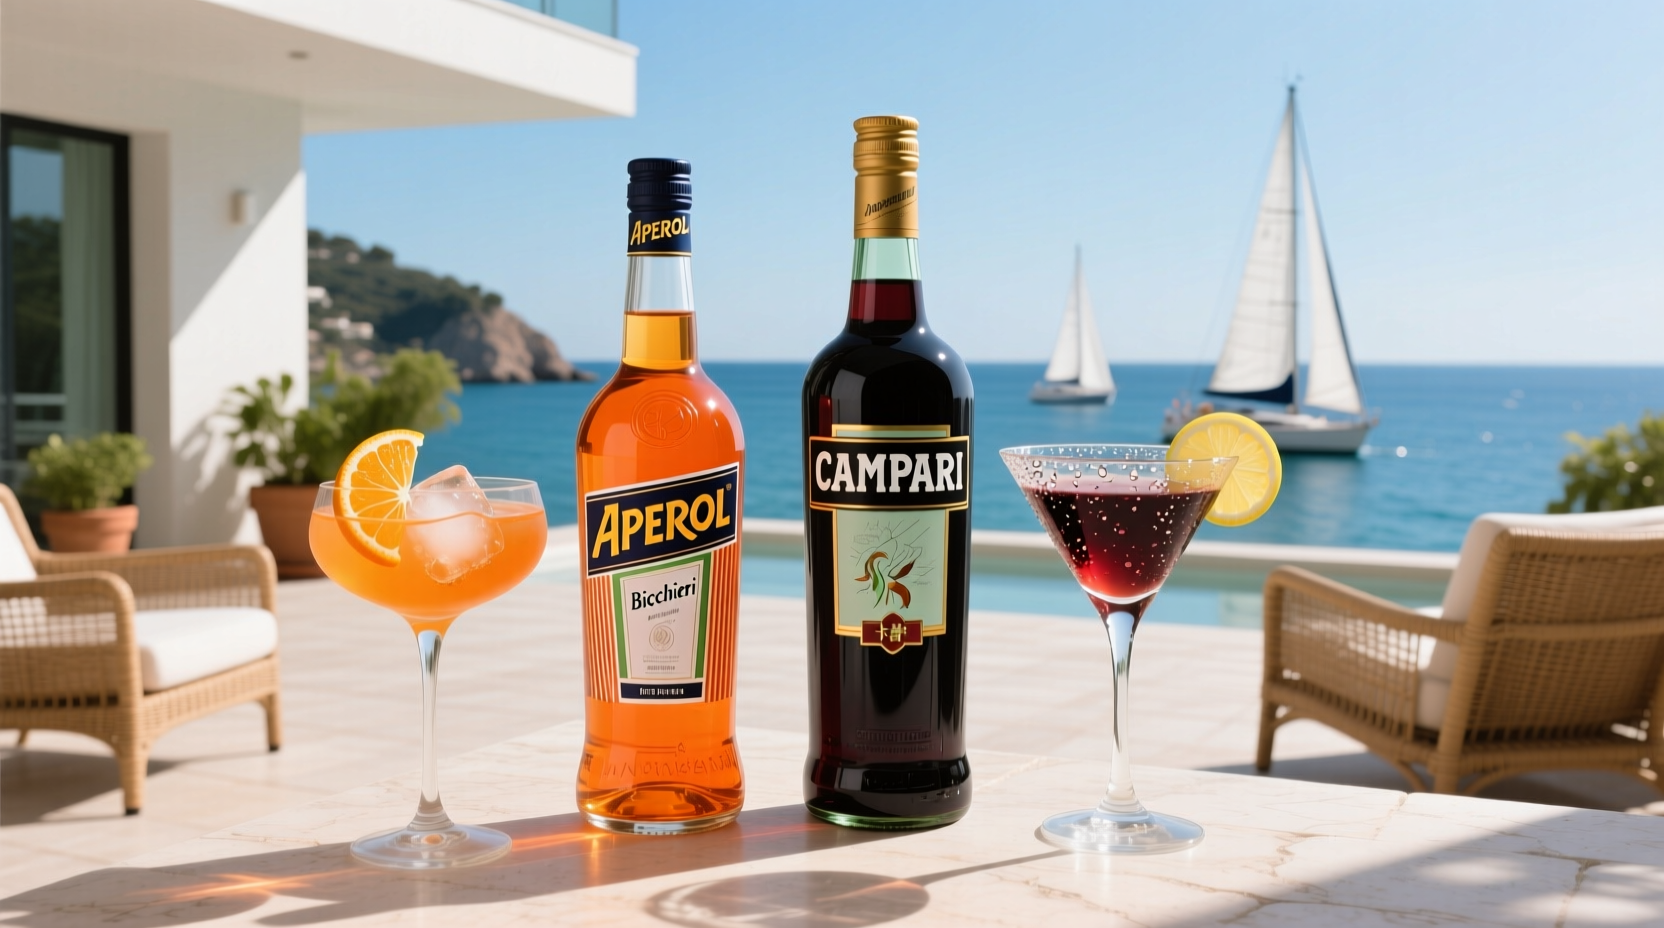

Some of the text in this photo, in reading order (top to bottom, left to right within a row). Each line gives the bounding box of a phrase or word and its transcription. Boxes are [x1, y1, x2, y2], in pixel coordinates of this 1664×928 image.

[630, 215, 690, 246] APEROL
[815, 451, 964, 493] CAMPARI
[592, 488, 731, 559] APEROL
[631, 577, 697, 611] Bicchieri
